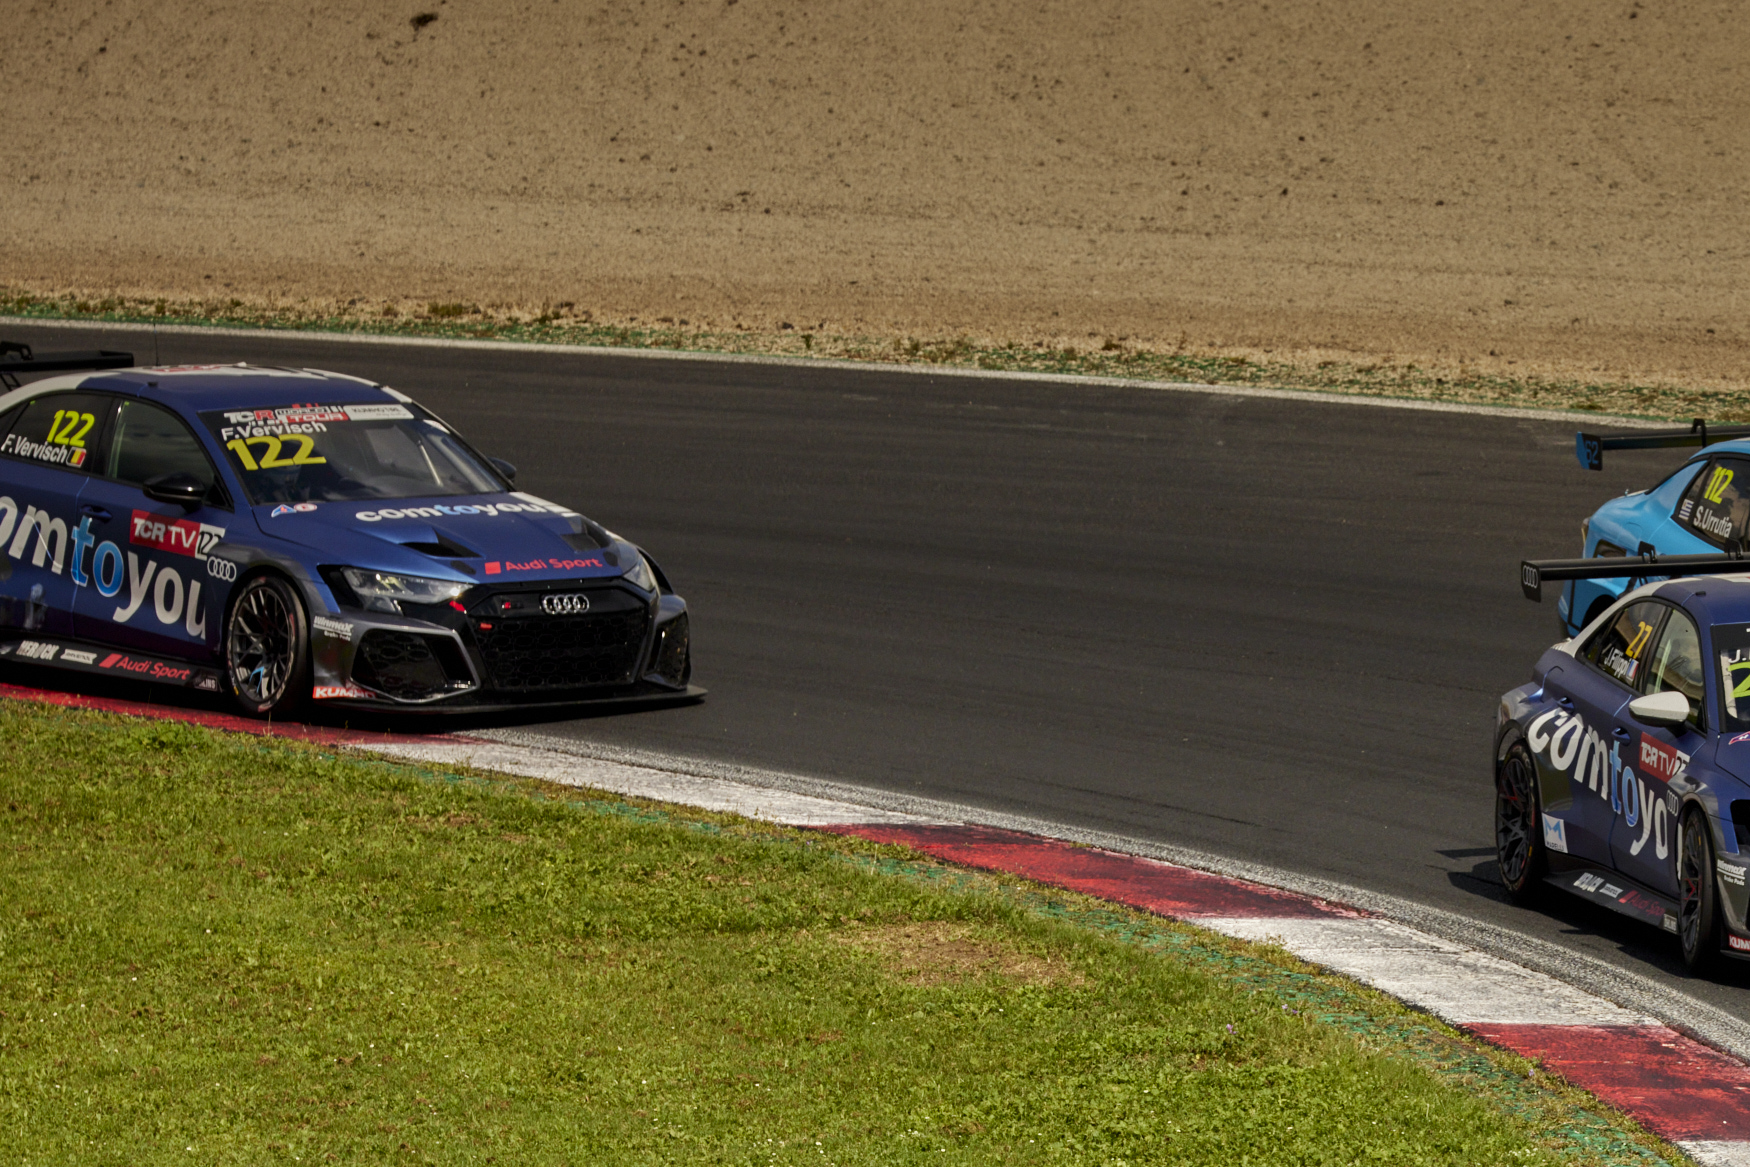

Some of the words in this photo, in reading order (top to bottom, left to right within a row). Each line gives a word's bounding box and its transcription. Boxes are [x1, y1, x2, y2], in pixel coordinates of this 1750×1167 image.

[47, 409, 95, 447] 122
[221, 421, 328, 441] F.Vervisch
[224, 410, 276, 424] TCR
[1, 433, 68, 463] F.Vervisch
[226, 433, 327, 471] 122
[1704, 466, 1734, 505] 112
[355, 500, 548, 522] comtoyou
[1693, 505, 1733, 538] S.Urrutia
[133, 517, 165, 542] TCR
[168, 525, 196, 548] TV
[0, 496, 206, 640] omtoyou
[506, 559, 547, 572] Audi
[549, 557, 602, 571] Sport
[1625, 621, 1653, 659] 27
[116, 656, 151, 673] Audi
[151, 662, 191, 681] Sport
[1640, 741, 1658, 767] TCR
[1659, 751, 1674, 777] TV
[1528, 707, 1683, 880] comtoyo
